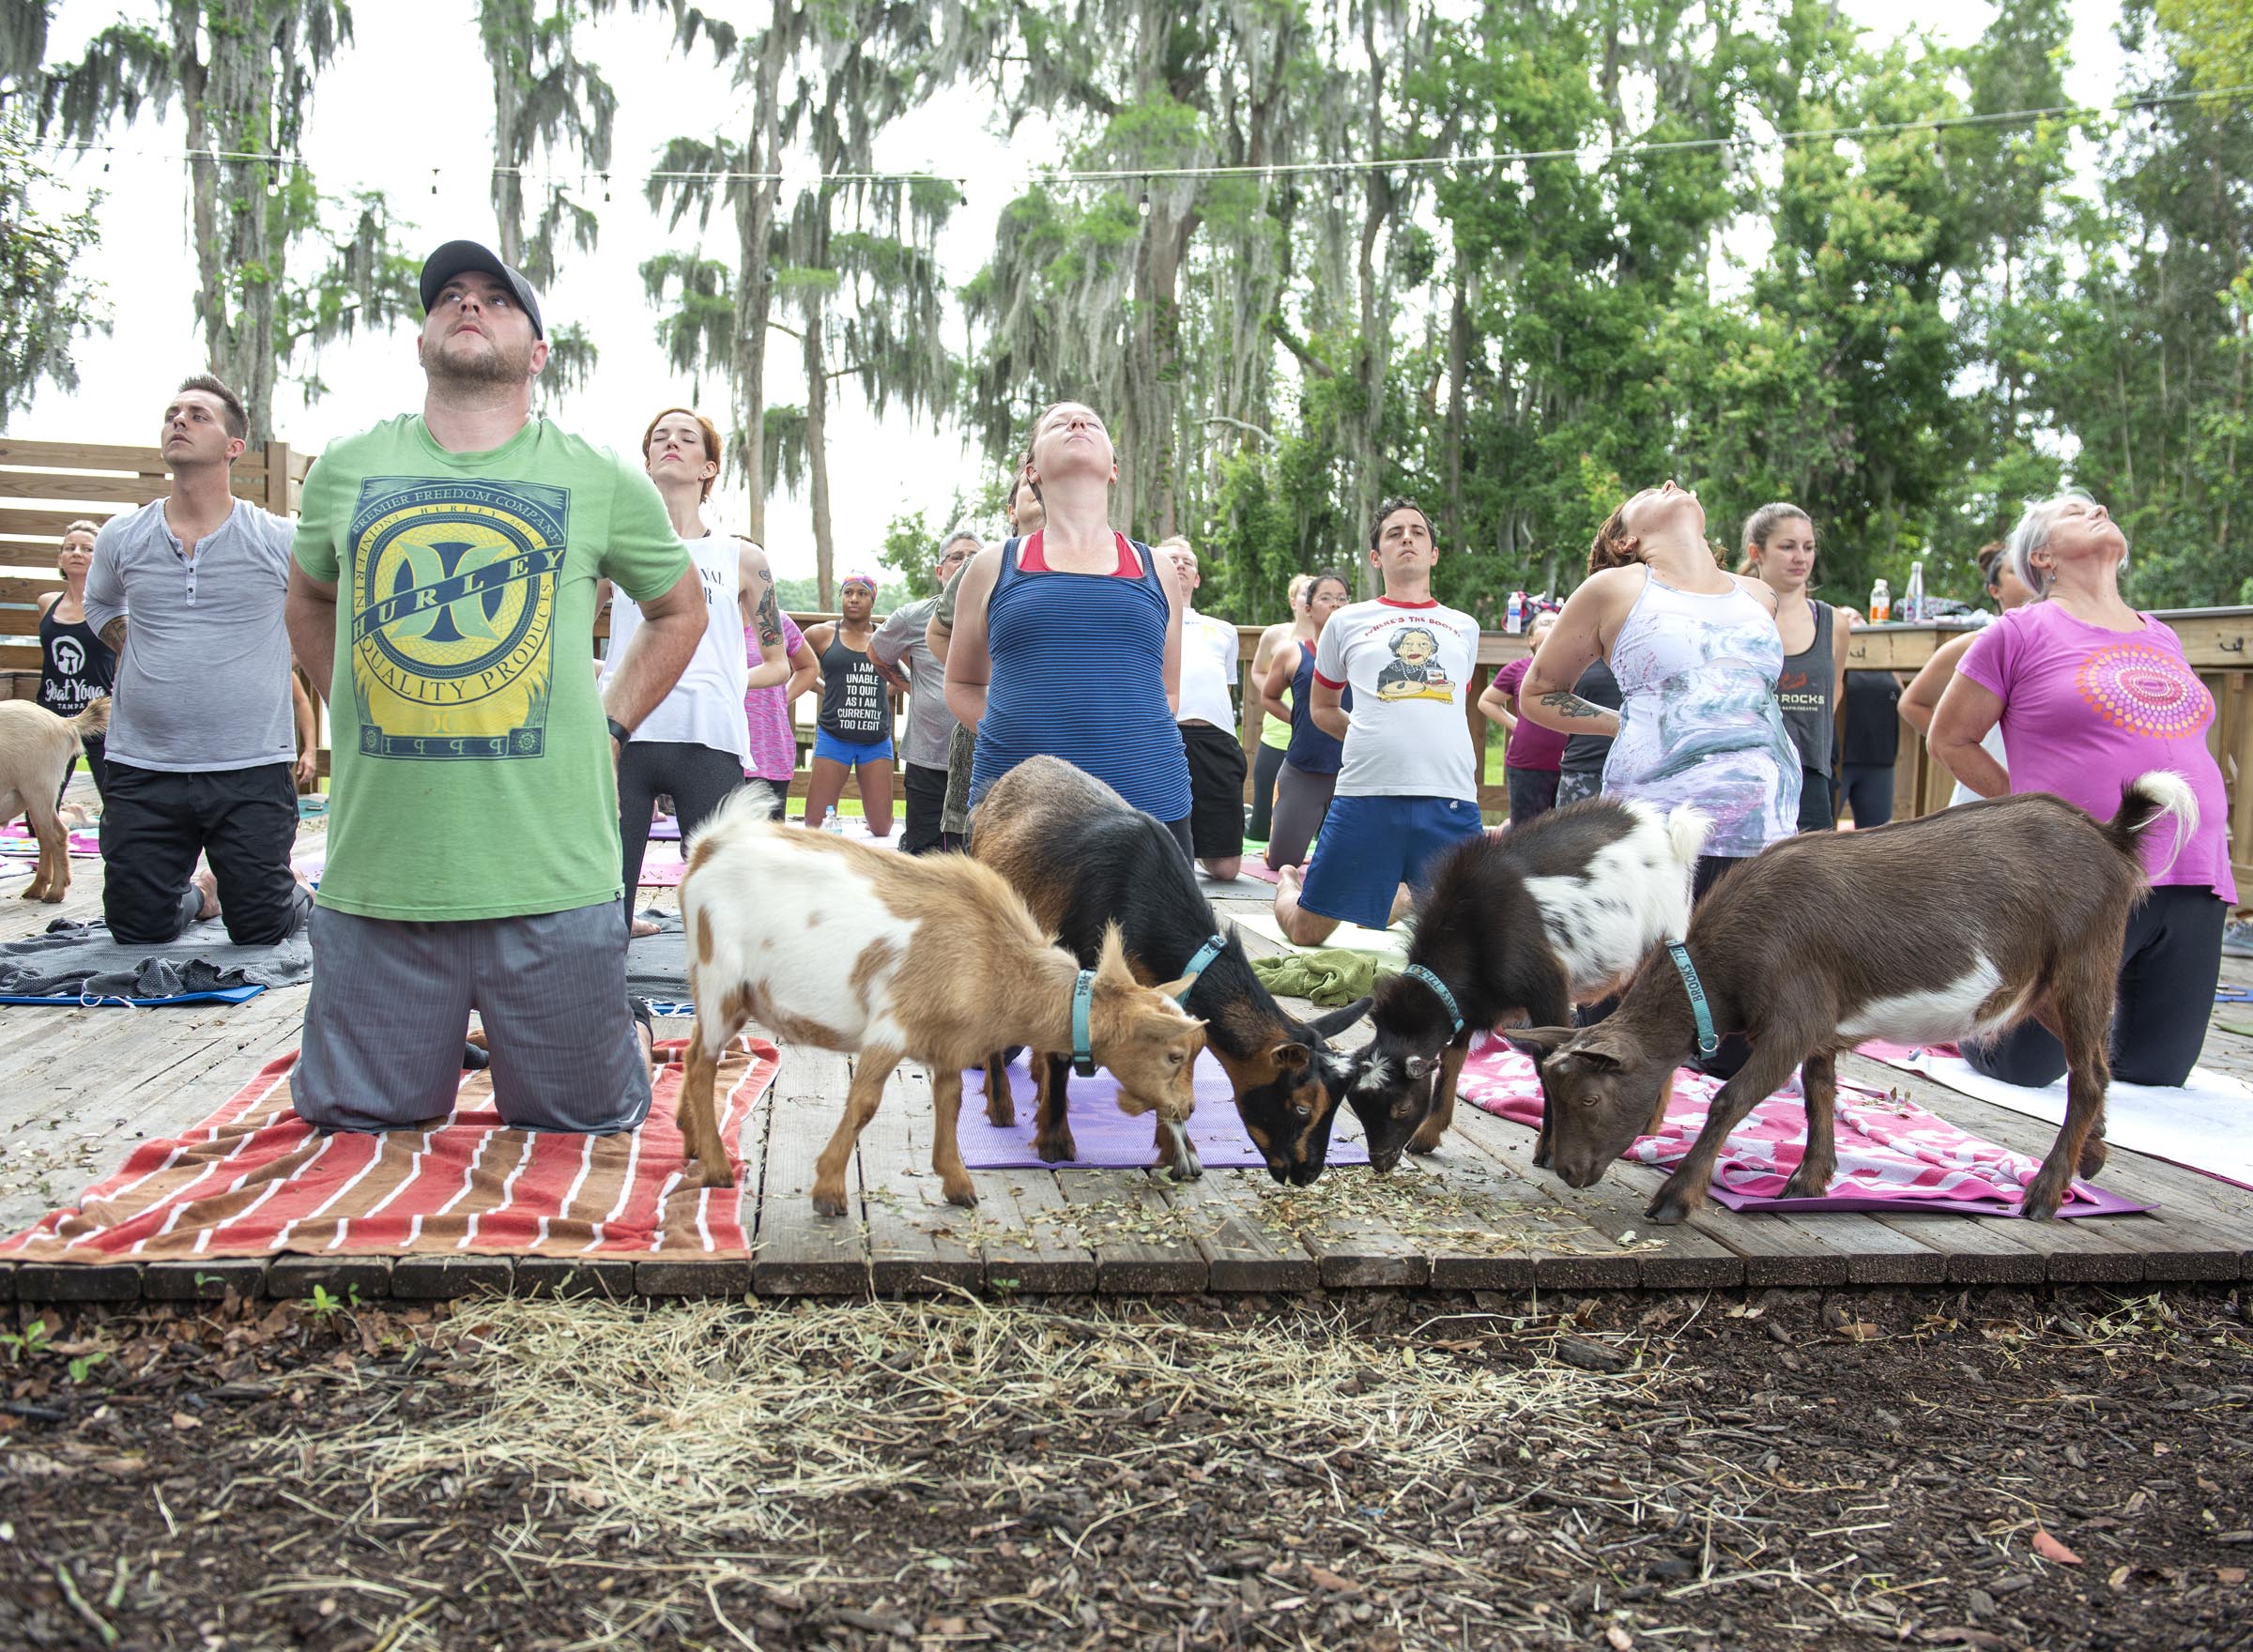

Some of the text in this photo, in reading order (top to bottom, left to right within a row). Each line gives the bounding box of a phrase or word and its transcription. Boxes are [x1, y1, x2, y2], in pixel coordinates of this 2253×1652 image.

[353, 488, 562, 543] PREMIER FREEDOM COMPANY
[421, 505, 498, 518] HURLEY
[355, 514, 399, 608] ENGINEERIN
[353, 549, 563, 639] HURLEY
[361, 584, 552, 701] QUALITY PRODUCTS
[853, 663, 874, 673] I AM
[846, 673, 879, 685] UNABLE
[70, 678, 106, 702] Yoga
[847, 685, 878, 696] TO QUIT
[845, 696, 877, 708] AS I AM
[1781, 694, 1825, 705] ROCKS
[837, 708, 882, 720] CURRENTLY
[839, 719, 880, 731] TOO LEGIT
[1680, 964, 1704, 1002] BROOKS
